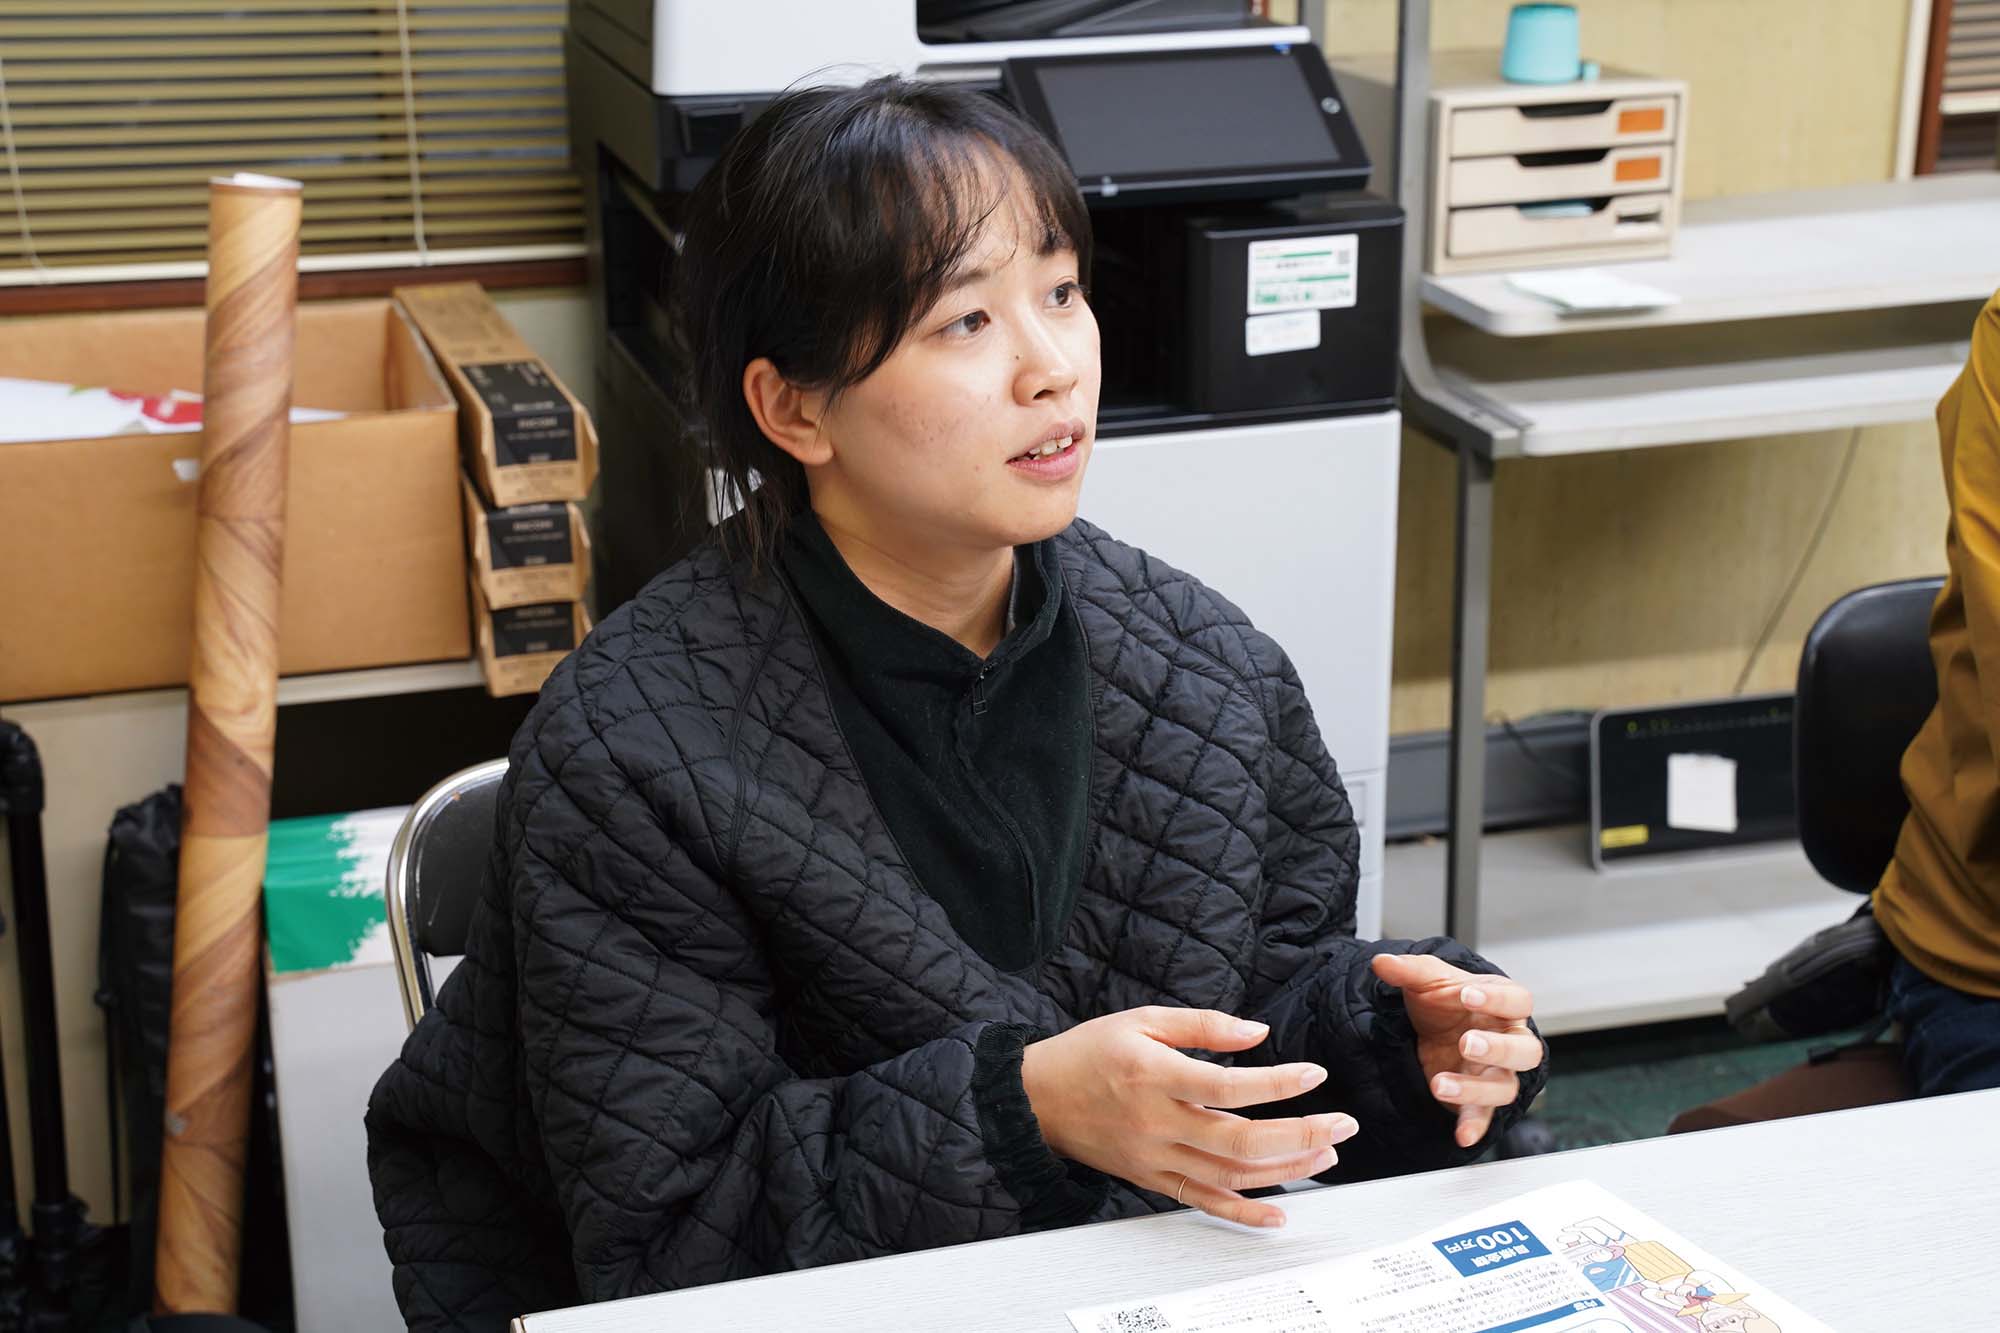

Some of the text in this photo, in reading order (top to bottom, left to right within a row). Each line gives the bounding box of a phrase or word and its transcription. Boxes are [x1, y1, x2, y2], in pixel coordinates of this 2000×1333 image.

[1445, 1227, 1529, 1253] 100万円
[1470, 1245, 1529, 1267] 目標金額
